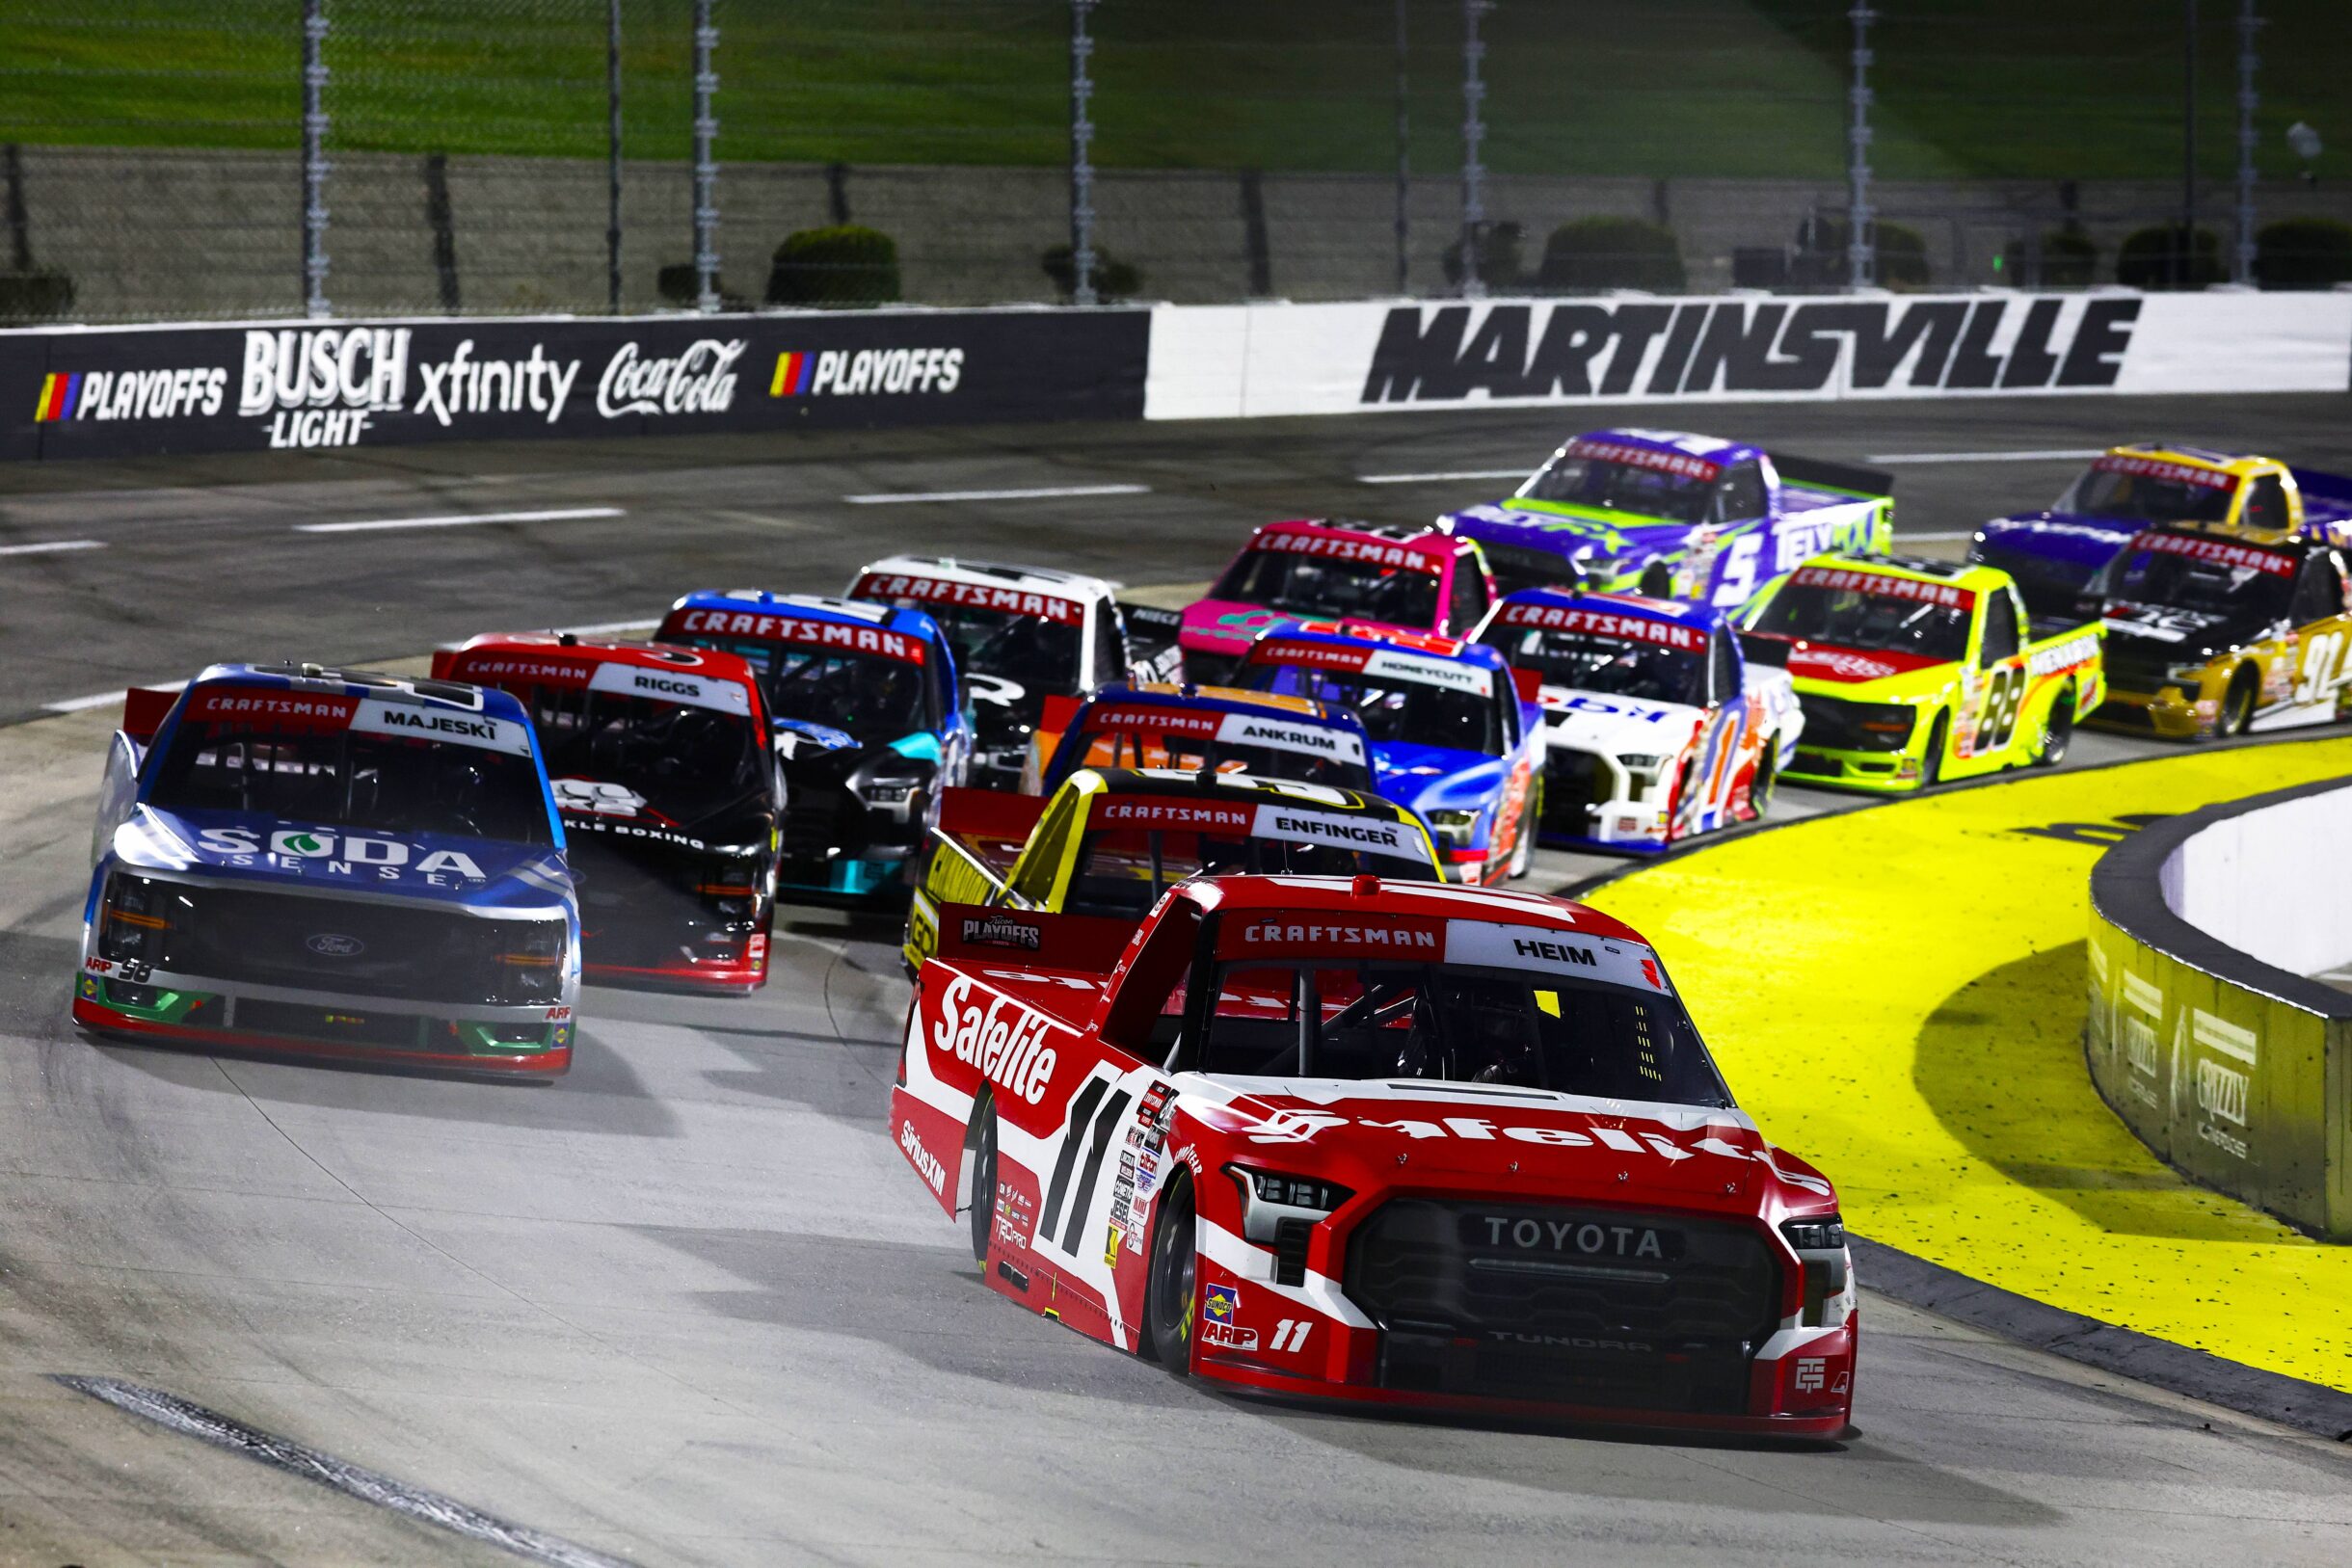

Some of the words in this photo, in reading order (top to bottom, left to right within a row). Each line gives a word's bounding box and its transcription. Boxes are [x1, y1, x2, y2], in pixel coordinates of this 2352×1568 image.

[238, 329, 413, 416] BUSCH
[812, 348, 964, 396] PLAYOFFS
[1360, 298, 2143, 404] MARTINSVILLE
[77, 368, 227, 420] PLAYOFFS
[414, 340, 581, 425] xfinity
[1565, 439, 1705, 477] CRAFTSMAN
[2094, 456, 2228, 486] CRAFTSMAN
[1256, 532, 1426, 570] CRAFTSMAN
[1711, 532, 1764, 607] 5
[2138, 534, 2283, 572] CRAFTSMAN
[868, 575, 1069, 620] CRAFTSMAN
[1795, 567, 1961, 605] CRAFTSMAN
[682, 610, 907, 656] CRAFTSMAN
[1504, 604, 1692, 648] CRAFTSMAN
[467, 661, 587, 679] CRAFTSMAN
[634, 675, 700, 697] RIGGS
[1265, 647, 1364, 665] CRAFTSMAN
[1380, 660, 1475, 684] HONEYCUTT
[205, 697, 348, 719] CRAFTSMAN
[384, 710, 496, 740] MAJESKI
[1974, 665, 2026, 752] 88
[1099, 712, 1215, 731] CRAFTSMAN
[1243, 726, 1336, 750] ANKRUM
[615, 826, 705, 850] BOXING
[1105, 804, 1246, 826] CRAFTSMAN
[1275, 816, 1399, 848] ENFINGER
[198, 827, 486, 879] SODA
[232, 854, 446, 887] SENSE
[317, 936, 354, 953] Ford
[964, 919, 1039, 948] PLAYOFFS
[1244, 924, 1436, 948] CRAFTSMAN
[1514, 938, 1597, 967] HEIM
[85, 956, 113, 972] ARP
[934, 975, 1056, 1105] Safelite
[900, 1119, 947, 1197] SiriusXM
[1040, 1075, 1133, 1258] 11
[1484, 1215, 1662, 1259] TOYOTA
[1207, 1298, 1232, 1313] SUNOCO
[1203, 1321, 1258, 1347] ARP
[1270, 1318, 1313, 1353] 11
[1488, 1331, 1653, 1353] TUNDRA
